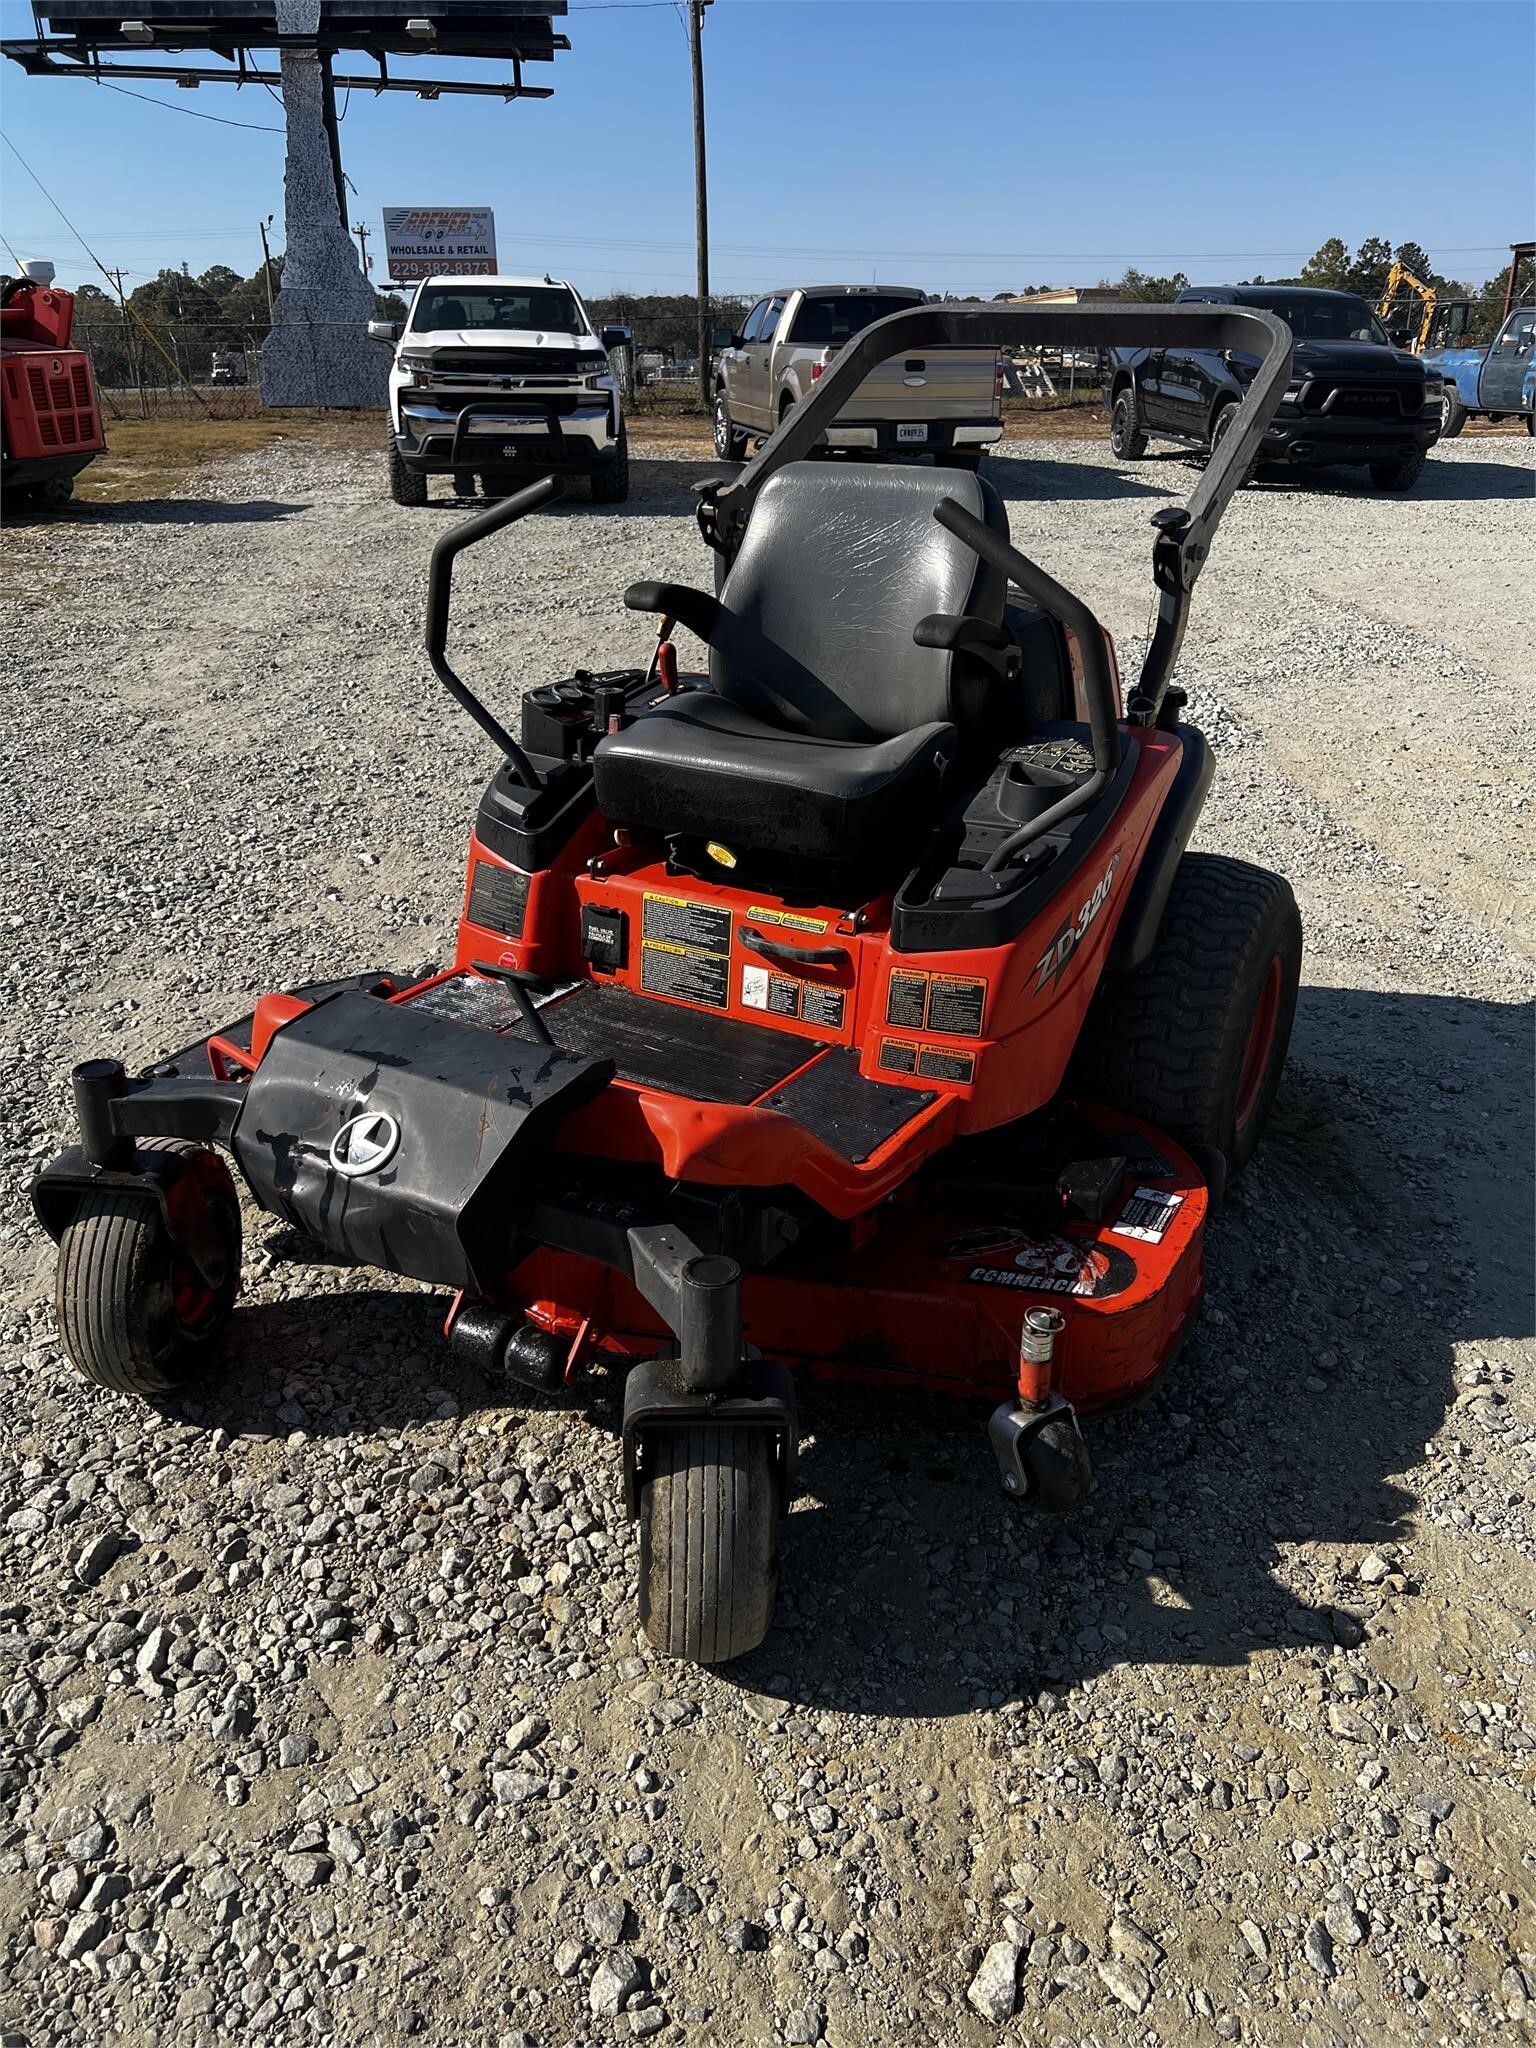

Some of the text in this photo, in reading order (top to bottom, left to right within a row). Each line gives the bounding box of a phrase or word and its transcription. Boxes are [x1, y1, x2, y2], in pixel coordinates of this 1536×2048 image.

[390, 246, 488, 254] WHOLESALE & RETAIL
[392, 262, 490, 276] 229-382-8373
[655, 896, 678, 905] CAUTION
[890, 1040, 915, 1048] WARNING
[930, 1046, 970, 1058] ADVERTENCIA
